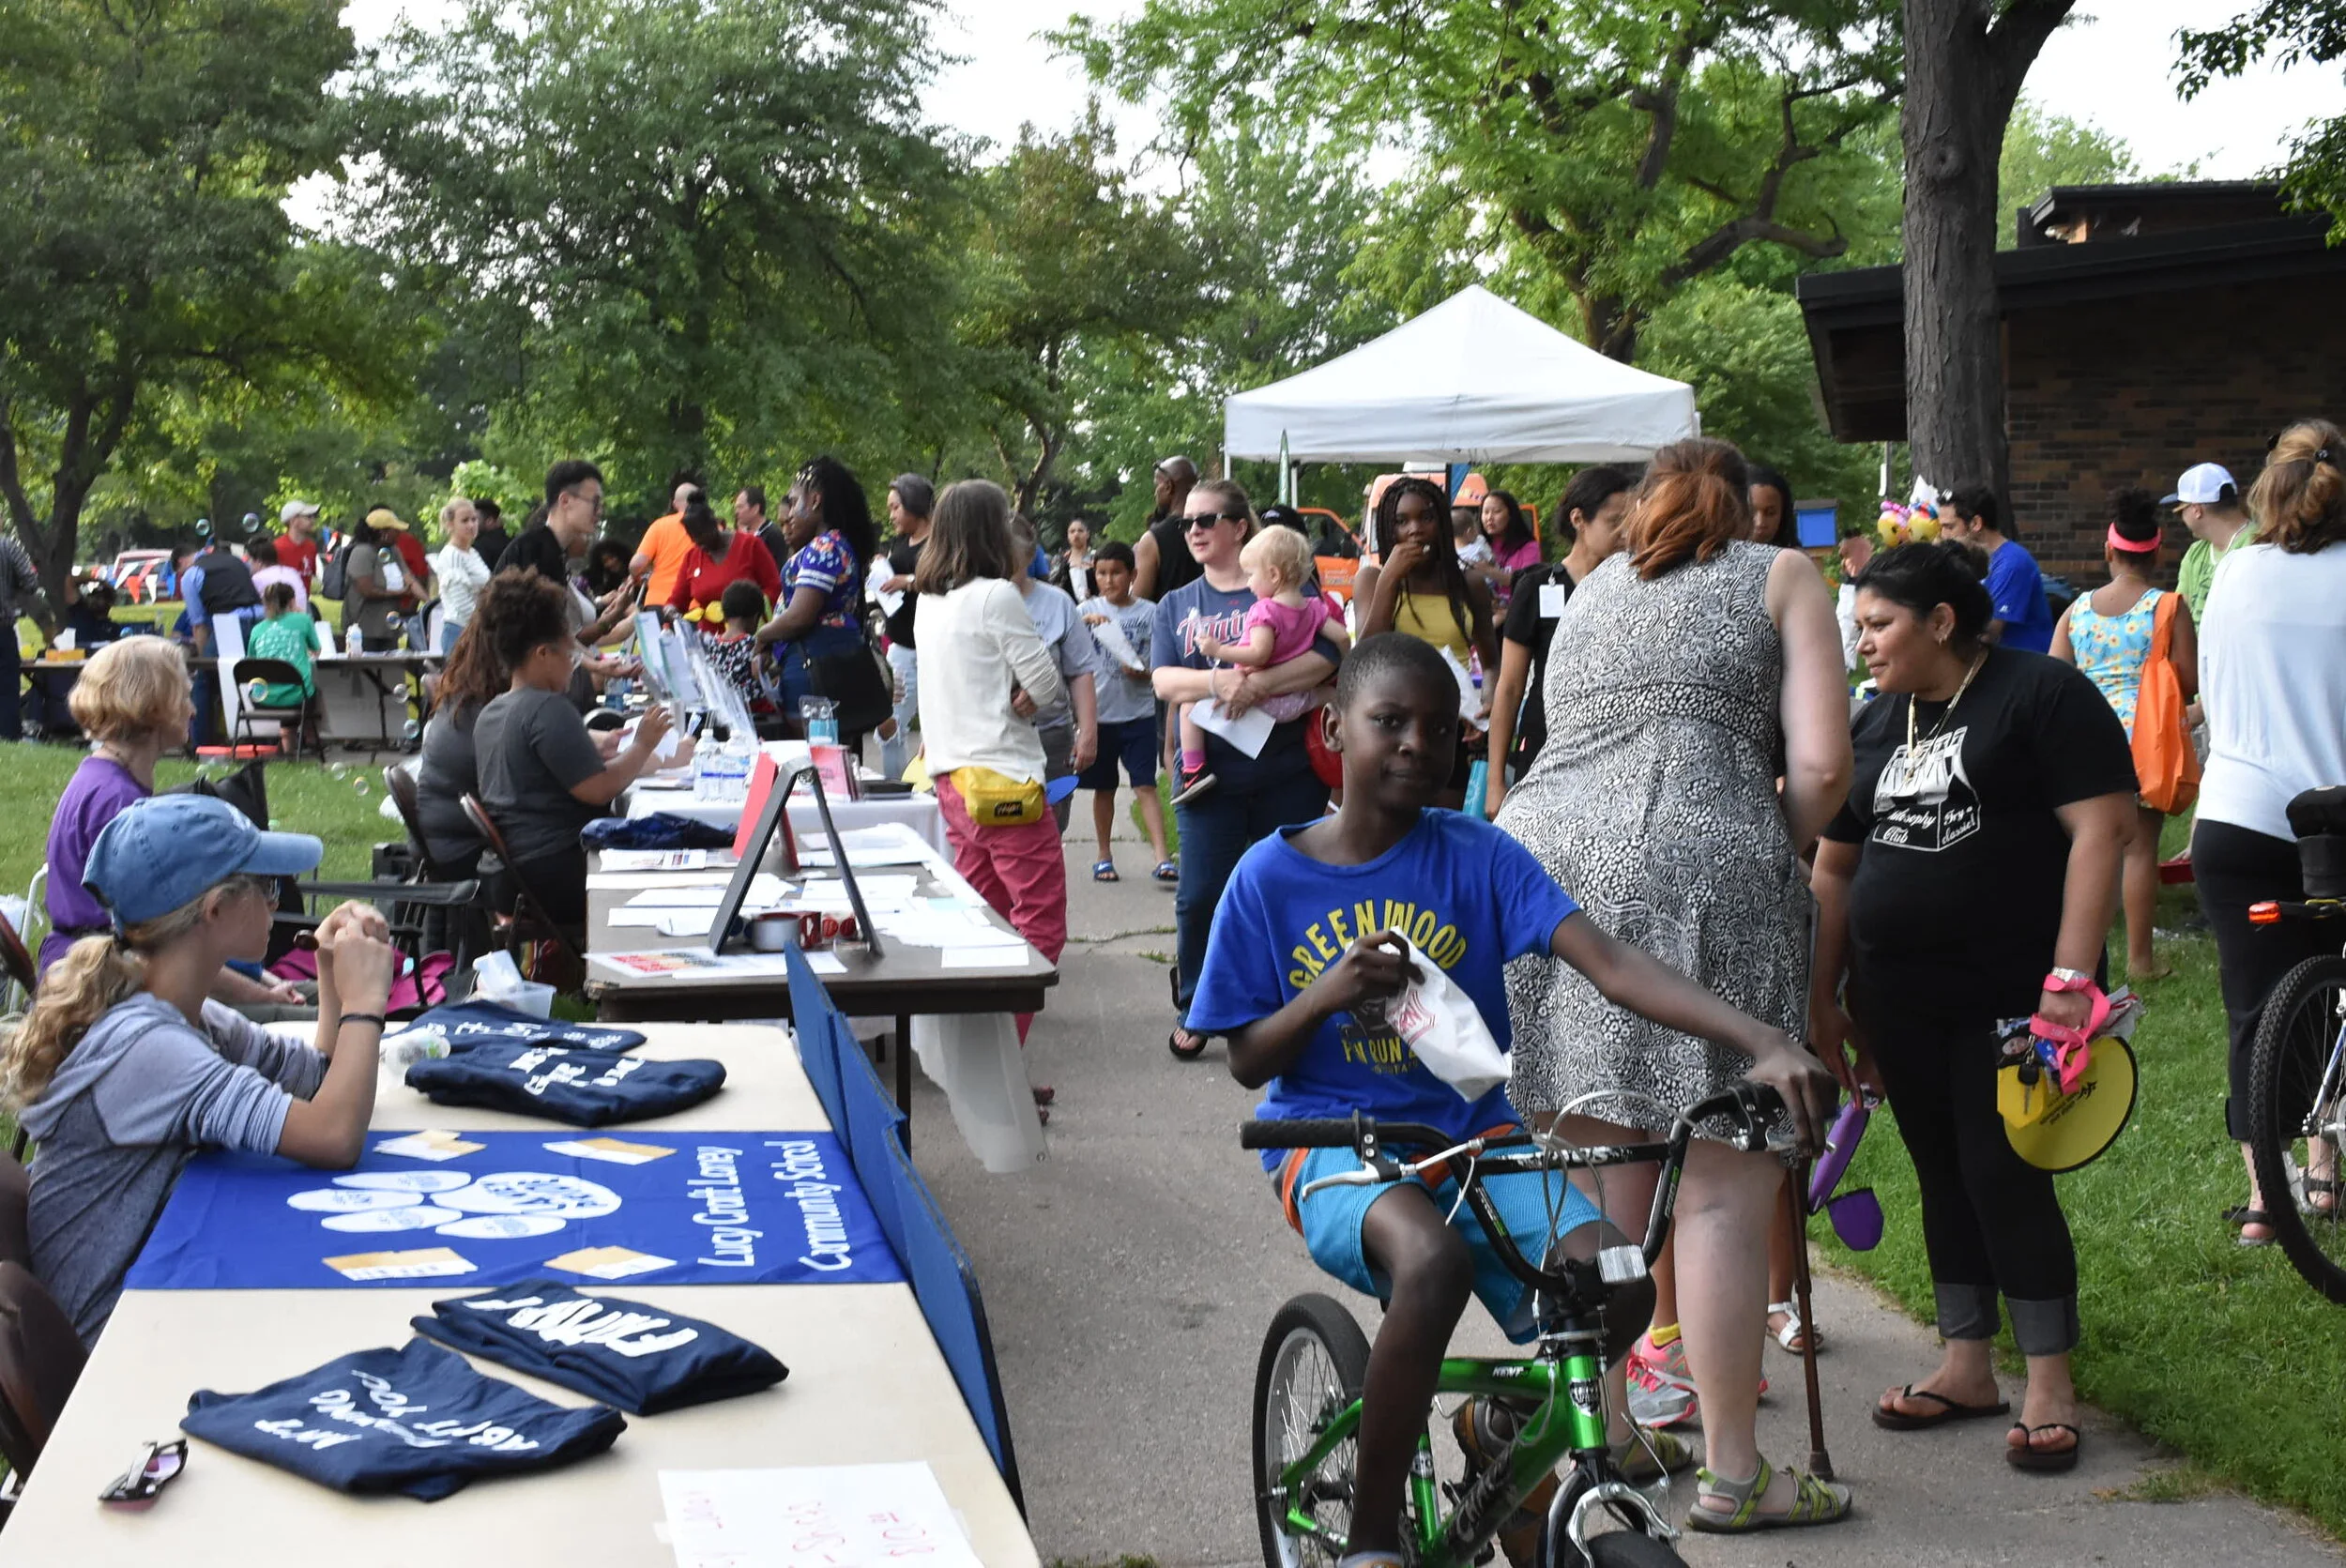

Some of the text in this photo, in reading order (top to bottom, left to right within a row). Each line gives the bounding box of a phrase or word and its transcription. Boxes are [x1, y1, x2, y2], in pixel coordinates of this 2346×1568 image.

[1943, 809, 1964, 826] Try
[1882, 826, 1909, 844] Club
[1289, 899, 1467, 990] GREENWOOD
[1368, 1037, 1402, 1063] RUN
[764, 1140, 852, 1271] Community School
[697, 1226, 764, 1267] Lucy
[1492, 1366, 1525, 1378] KENT
